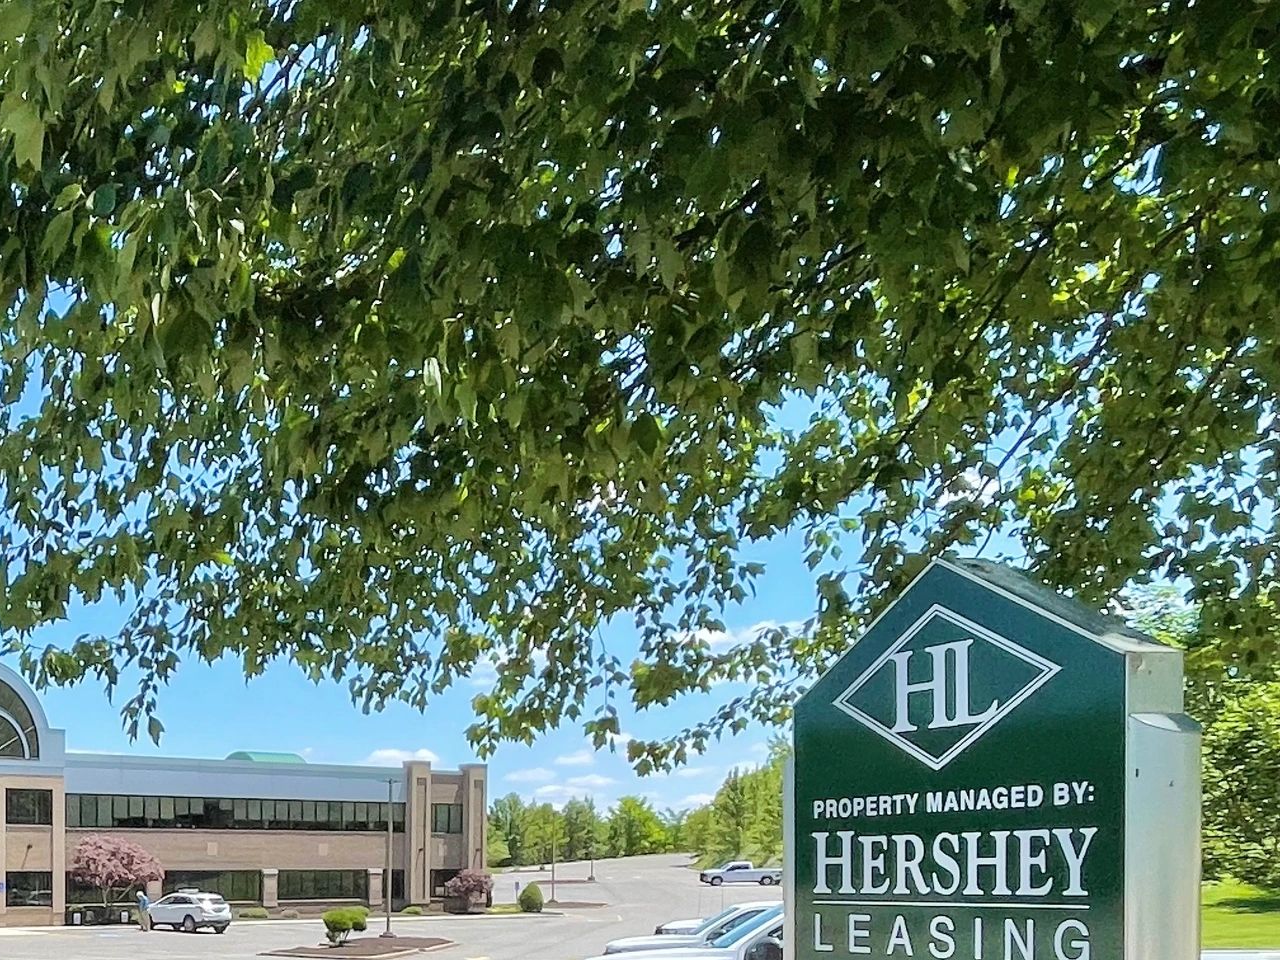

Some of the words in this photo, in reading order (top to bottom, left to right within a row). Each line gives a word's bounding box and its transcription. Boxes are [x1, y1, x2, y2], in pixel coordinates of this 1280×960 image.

[892, 638, 1000, 734] HL
[813, 793, 919, 819] PROPERTY
[926, 784, 1043, 813] MANAGED
[1053, 781, 1095, 805] BY:
[811, 827, 1097, 897] HERSHEY
